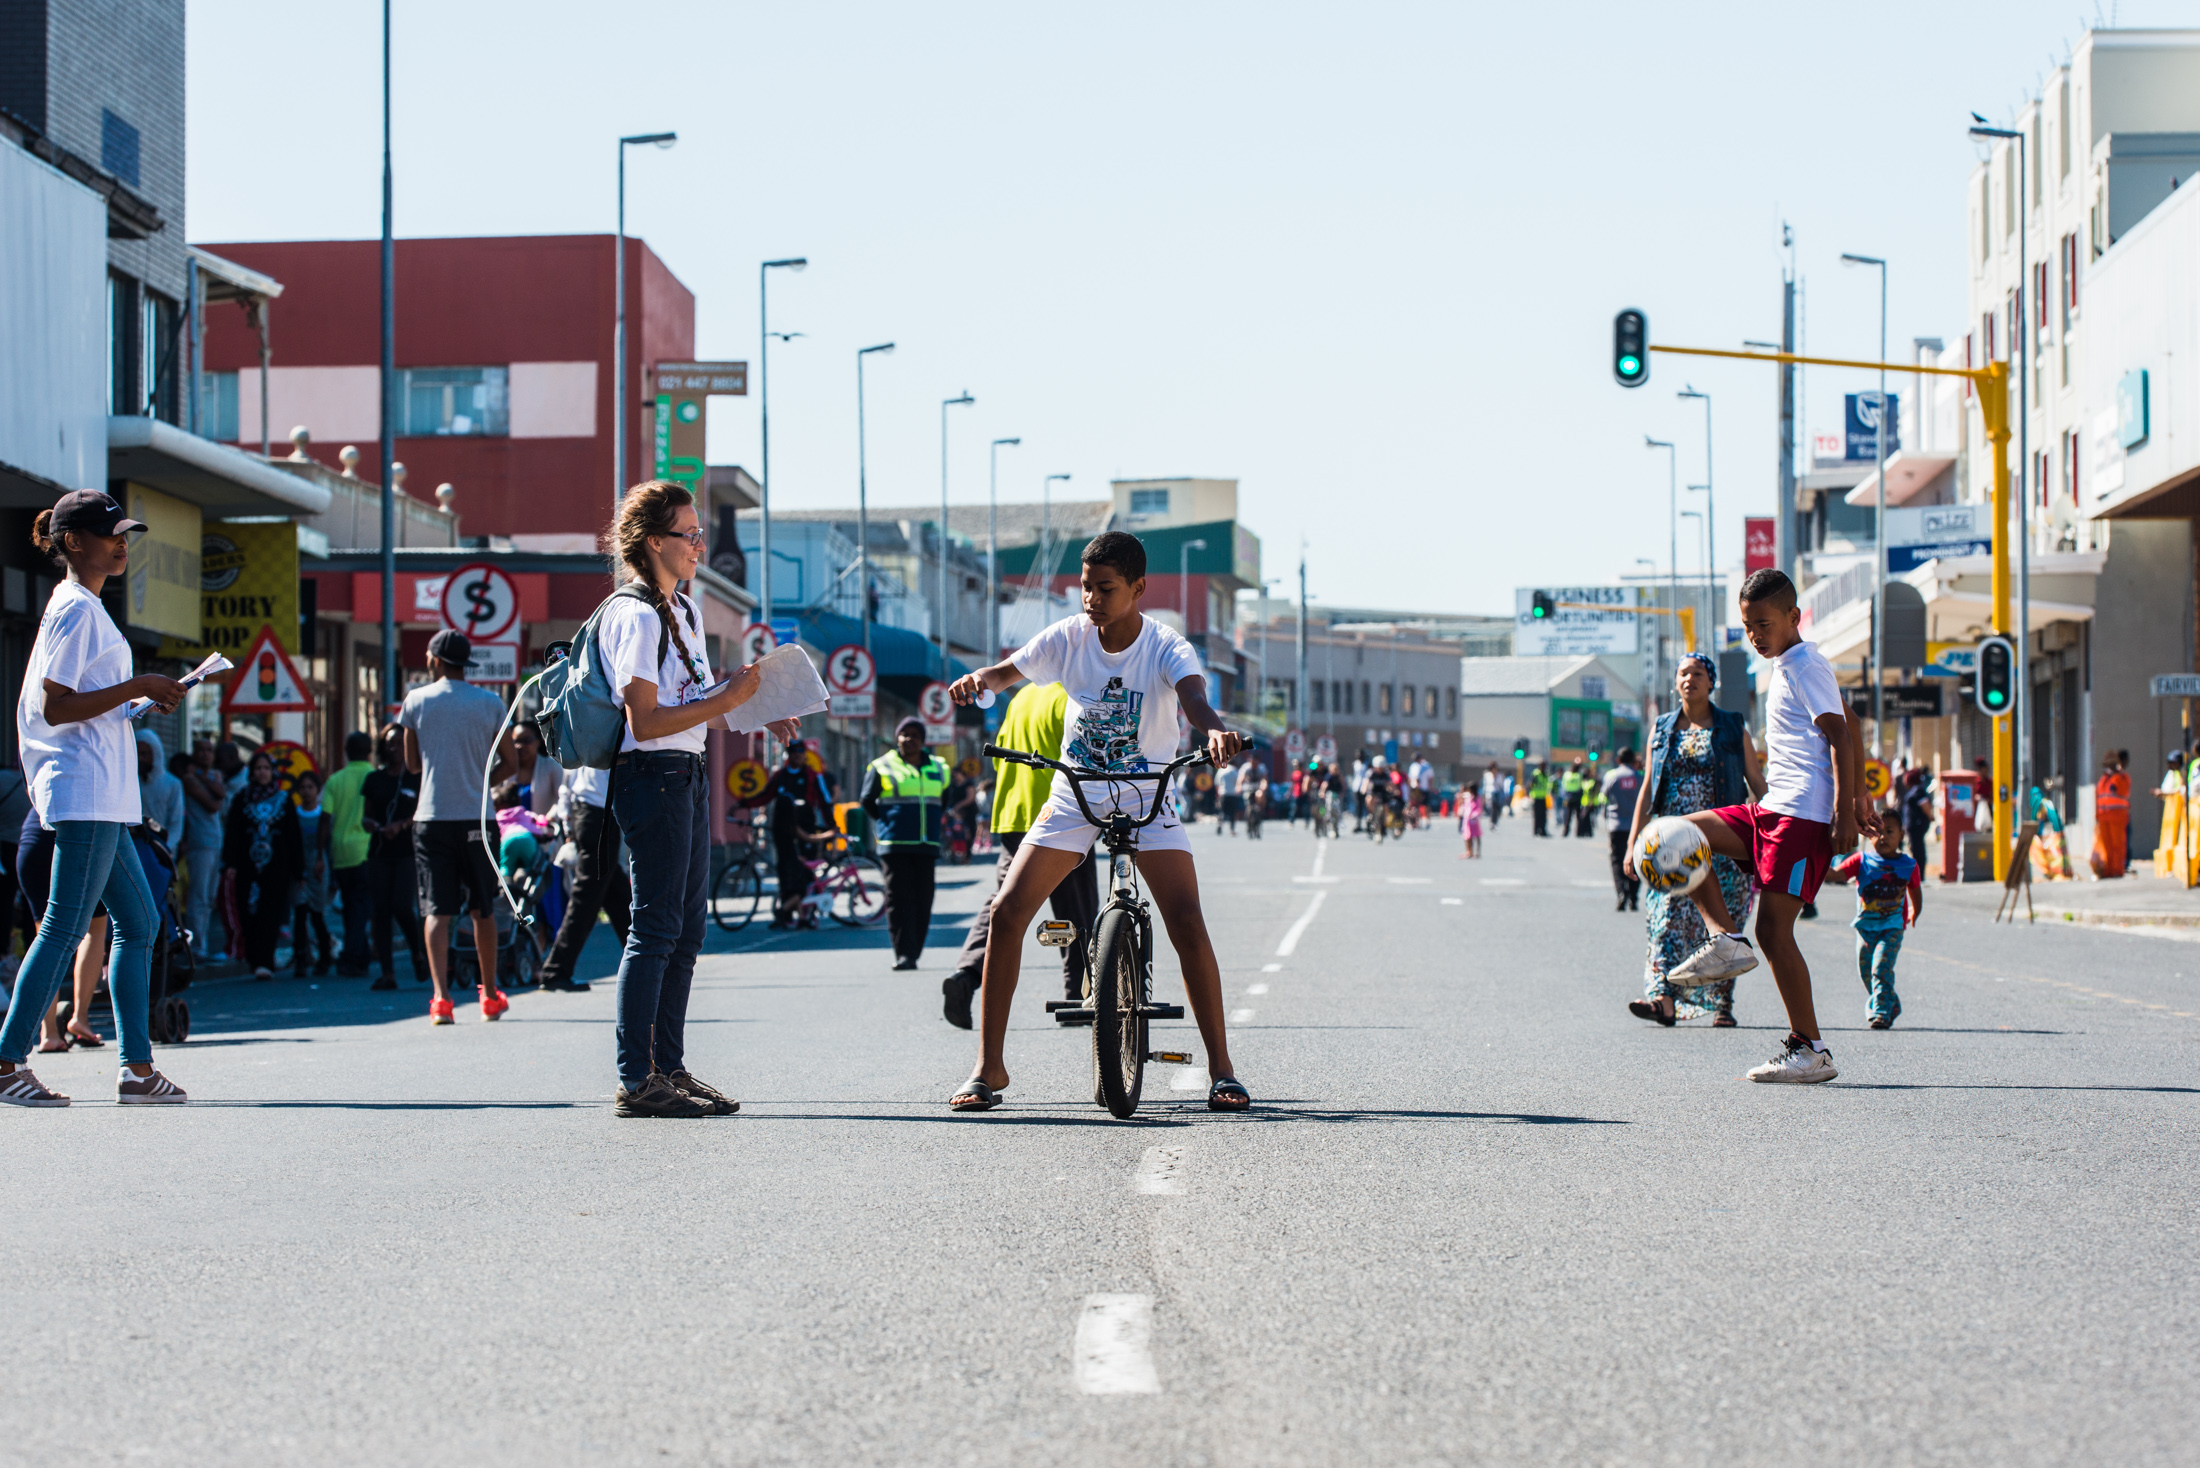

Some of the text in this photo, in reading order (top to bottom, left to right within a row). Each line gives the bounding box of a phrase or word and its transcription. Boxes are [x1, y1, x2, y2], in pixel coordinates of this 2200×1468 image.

[1815, 436, 1839, 451] TO
[202, 552, 246, 570] ADERS
[1545, 587, 1624, 604] USINESS
[201, 595, 276, 618] TORY
[1943, 652, 1974, 667] PE
